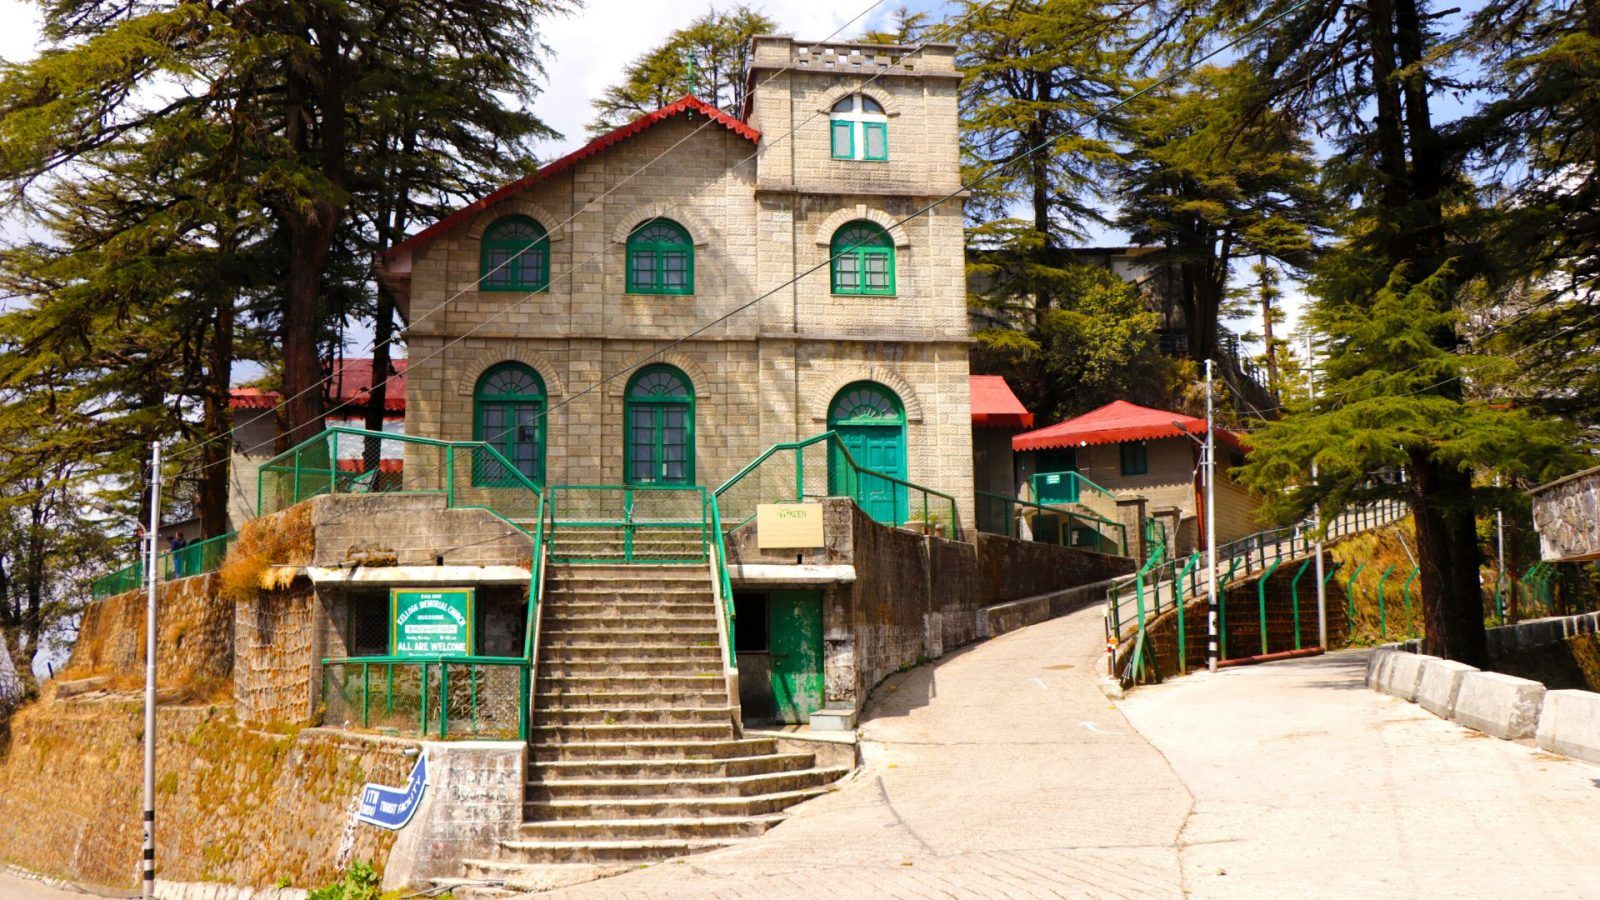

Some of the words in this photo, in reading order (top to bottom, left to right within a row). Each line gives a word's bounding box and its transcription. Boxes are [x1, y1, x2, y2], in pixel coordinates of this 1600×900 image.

[419, 600, 448, 612] MEMORIAL
[447, 605, 467, 627] CHURCH
[398, 642, 412, 651] ALL
[414, 642, 429, 651] ARE
[431, 642, 466, 652] WELCOME
